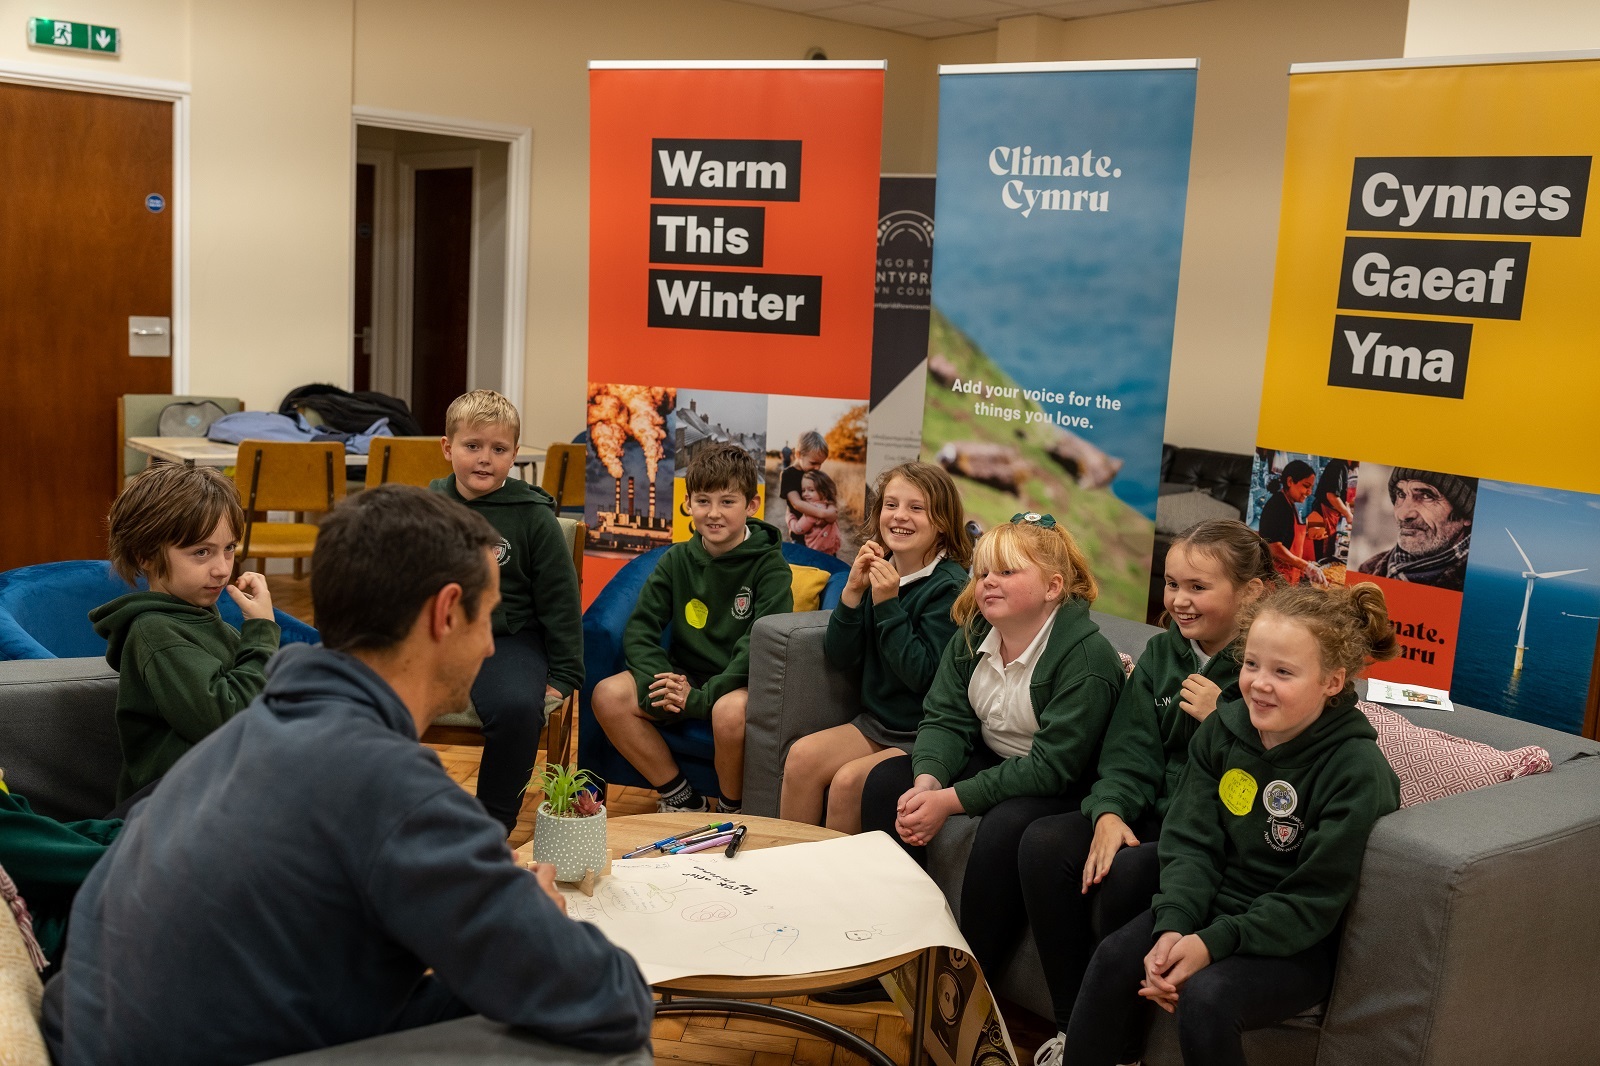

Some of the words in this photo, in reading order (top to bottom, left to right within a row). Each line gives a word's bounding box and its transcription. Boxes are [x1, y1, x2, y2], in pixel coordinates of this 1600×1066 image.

[658, 150, 787, 190] Warm
[988, 145, 1122, 178] Climate.
[1001, 179, 1109, 219] Cymru
[1361, 171, 1571, 227] Cynnes
[656, 215, 749, 255] This
[876, 257, 915, 268] NGOR
[876, 271, 931, 285] NTYPR
[1352, 252, 1516, 304] Gaeaf
[656, 279, 805, 321] Winter
[896, 286, 931, 296] COUN
[1343, 330, 1455, 383] Yma
[951, 378, 982, 395] Add
[985, 384, 1020, 398] your
[1023, 388, 1065, 404] voice
[1068, 390, 1092, 407] for
[1095, 394, 1122, 411] the
[974, 402, 1021, 421] things
[1025, 410, 1053, 424] you
[1056, 411, 1094, 430] love.
